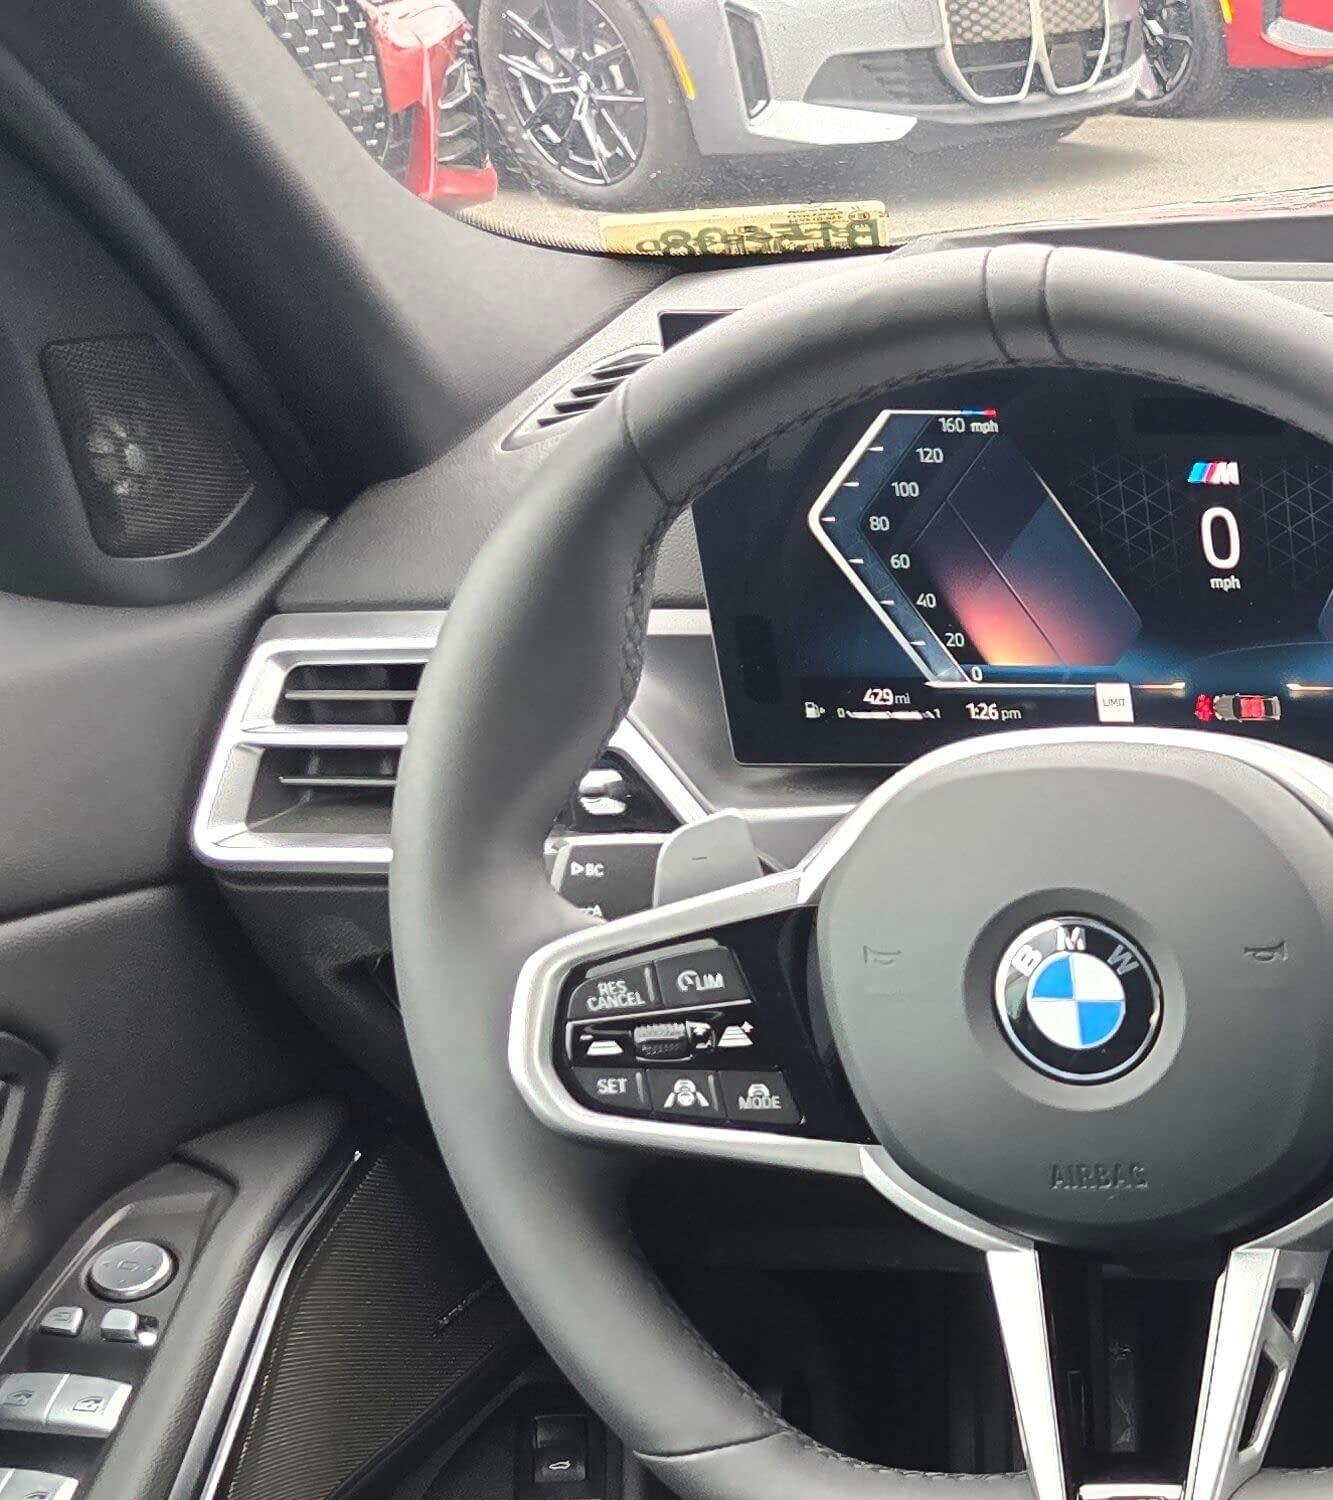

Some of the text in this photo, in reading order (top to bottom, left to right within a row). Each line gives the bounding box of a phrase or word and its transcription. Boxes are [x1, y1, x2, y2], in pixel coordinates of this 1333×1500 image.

[938, 417, 999, 435] 160 mph
[916, 447, 944, 464] 120
[891, 481, 919, 498] 100
[869, 516, 890, 532] 80
[1200, 506, 1241, 570] 0
[890, 554, 910, 570] 60
[1210, 576, 1241, 591] mph
[916, 593, 937, 609] 40
[945, 632, 965, 648] 20
[971, 666, 983, 681] 0
[863, 687, 911, 705] 429 mi
[1102, 698, 1126, 707] LIMIT
[965, 702, 1022, 722] 1:26 pm
[1011, 926, 1140, 977] BMW
[598, 980, 628, 995] RES
[696, 972, 725, 991] LIM
[586, 991, 647, 1011] CANCEL
[597, 1078, 628, 1094] SET
[739, 1096, 782, 1110] MODE
[1048, 1161, 1150, 1191] AIRBAG
